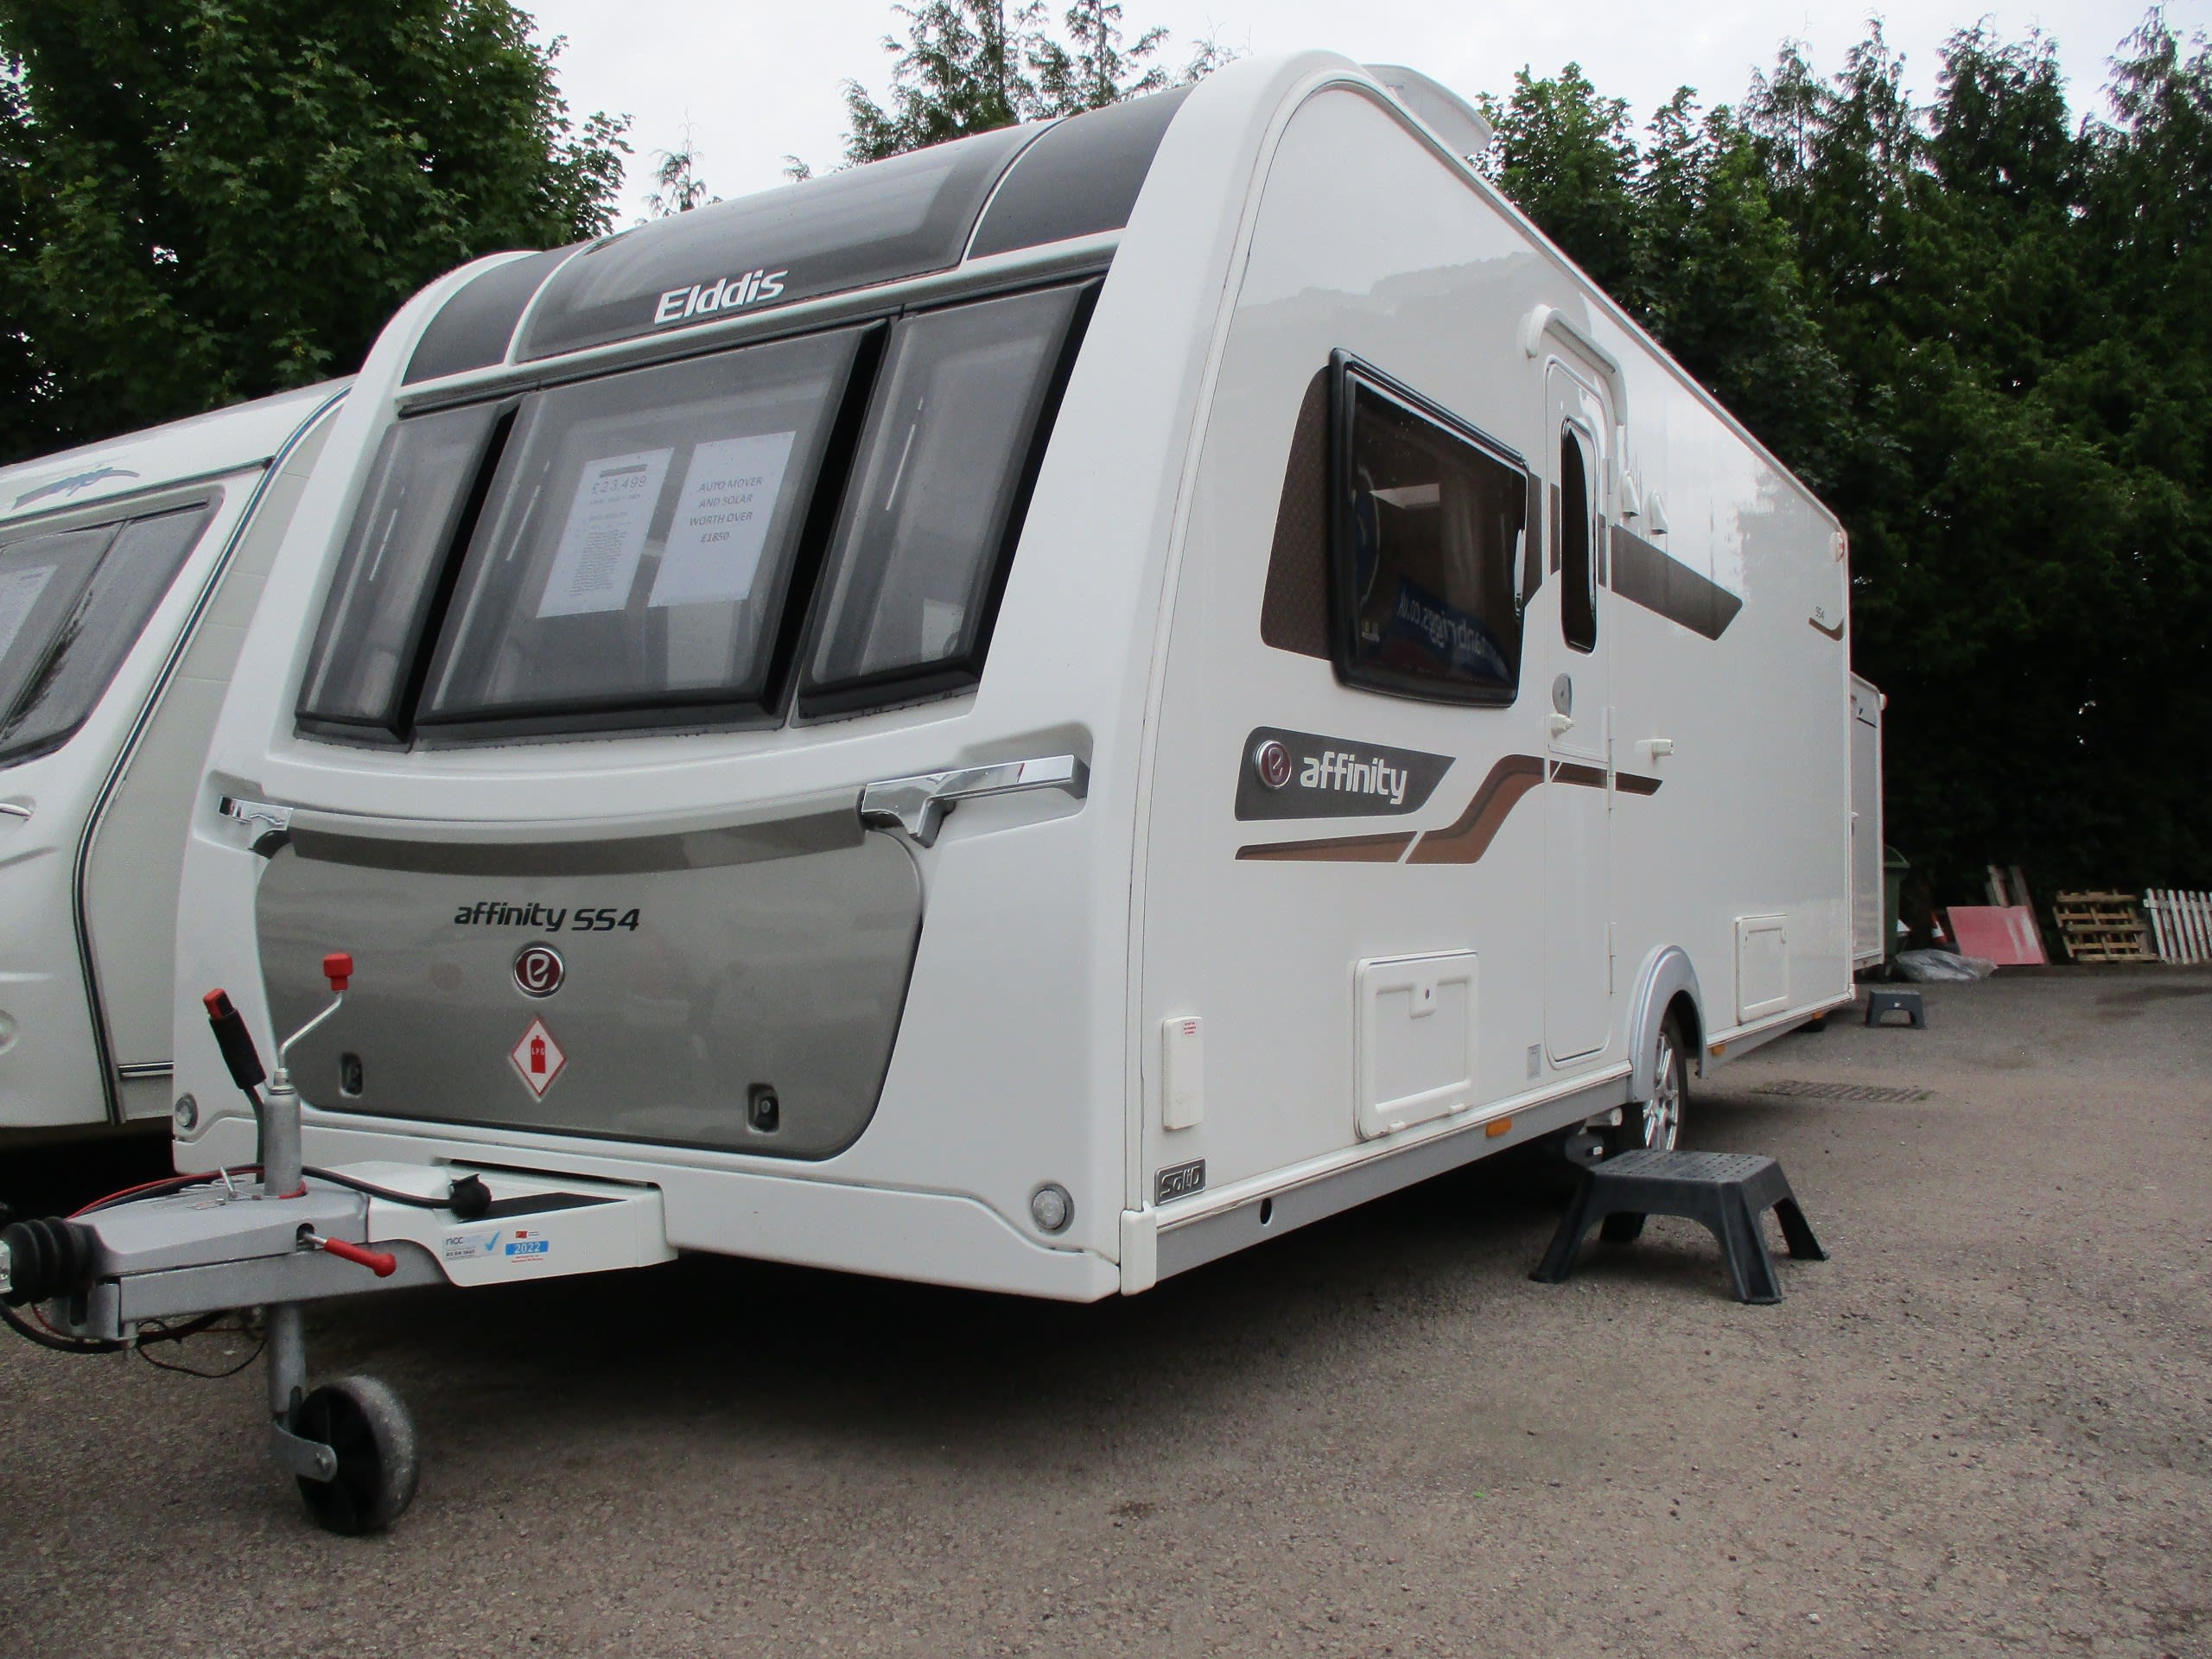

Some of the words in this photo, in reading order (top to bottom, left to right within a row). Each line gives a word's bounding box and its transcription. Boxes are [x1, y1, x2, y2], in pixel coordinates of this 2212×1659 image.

[654, 269, 789, 325] Elddis
[697, 481, 726, 493] AUTO
[727, 476, 762, 489] MOVER
[698, 497, 721, 508] AND
[721, 493, 753, 505] SOLAR
[690, 515, 725, 526] WORTH
[727, 511, 753, 523] OVER
[700, 531, 729, 543] £1850
[1300, 751, 1408, 805] affinity
[454, 902, 567, 932] affinity
[531, 1047, 545, 1056] LPG
[515, 1243, 541, 1254] 2022
